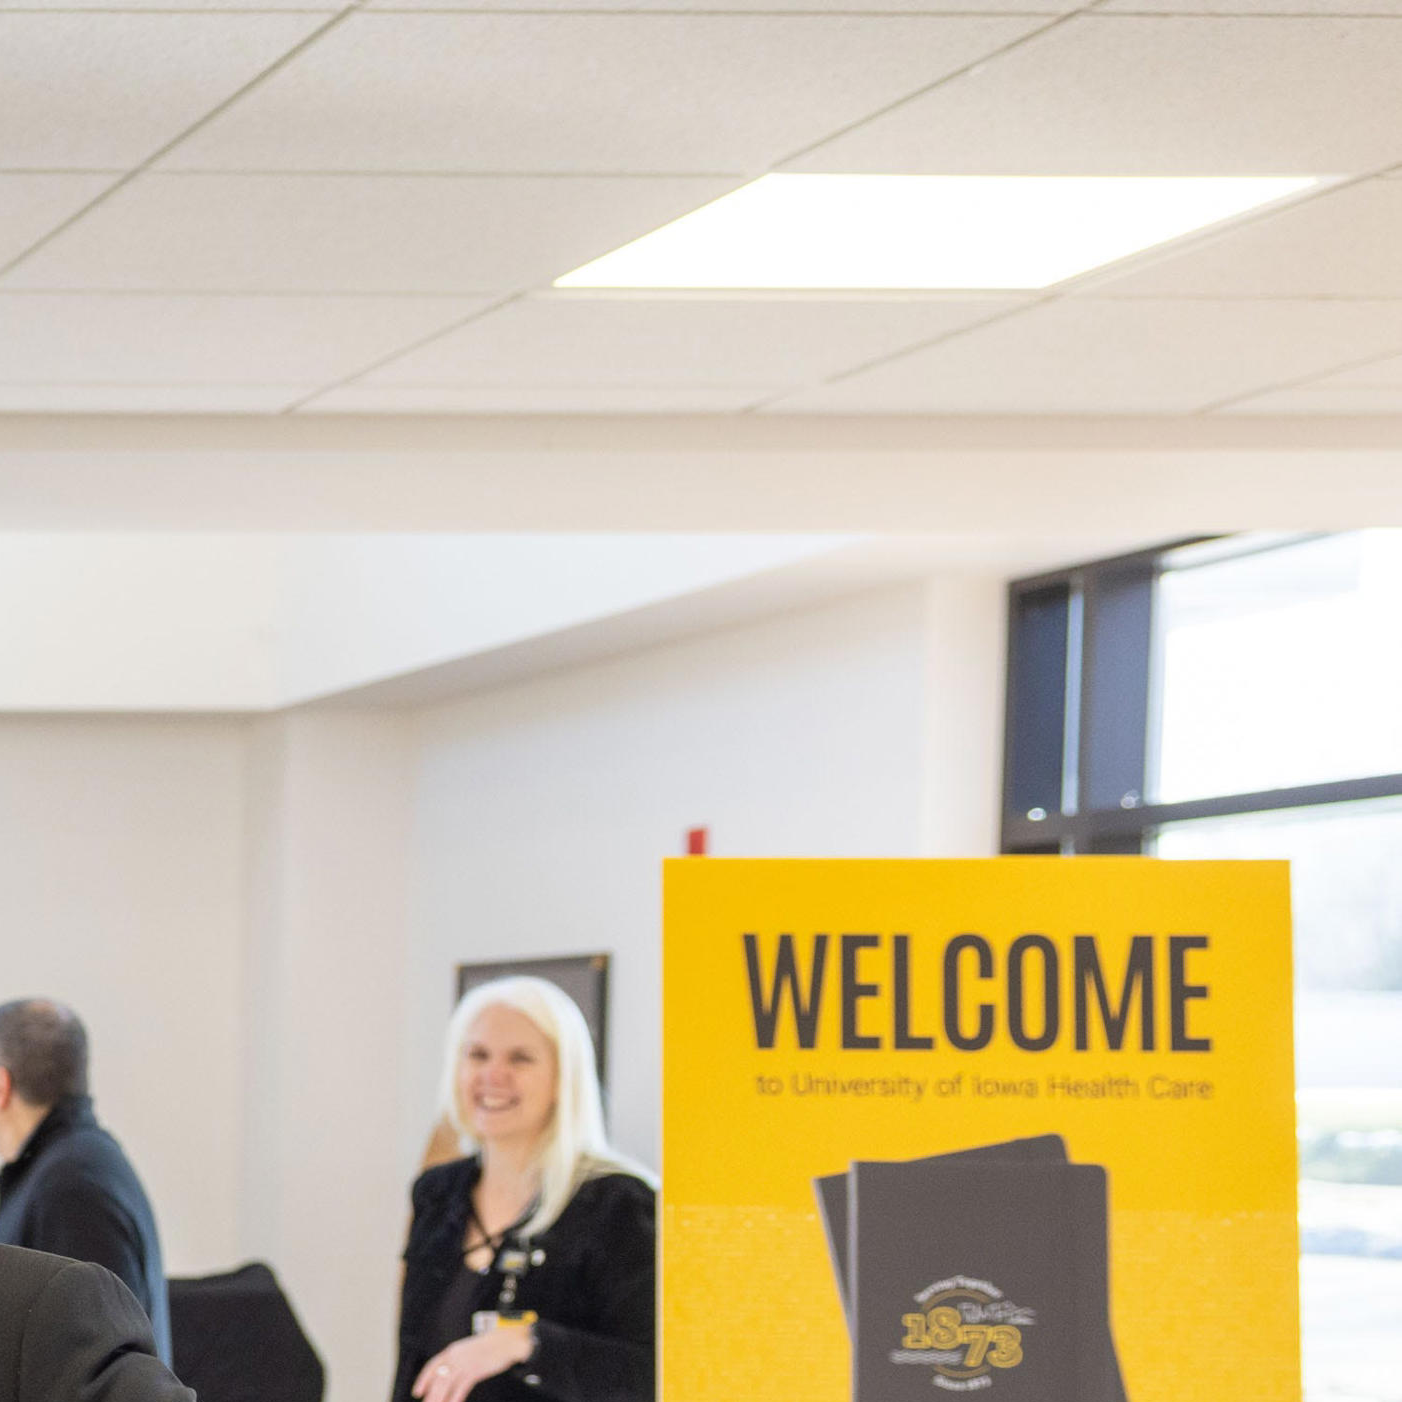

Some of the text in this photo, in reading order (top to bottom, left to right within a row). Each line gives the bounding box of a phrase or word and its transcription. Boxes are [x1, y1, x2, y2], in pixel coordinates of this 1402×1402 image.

[742, 933, 1212, 1053] WELCOME
[755, 1072, 1215, 1102] to University of Iowa Health Care
